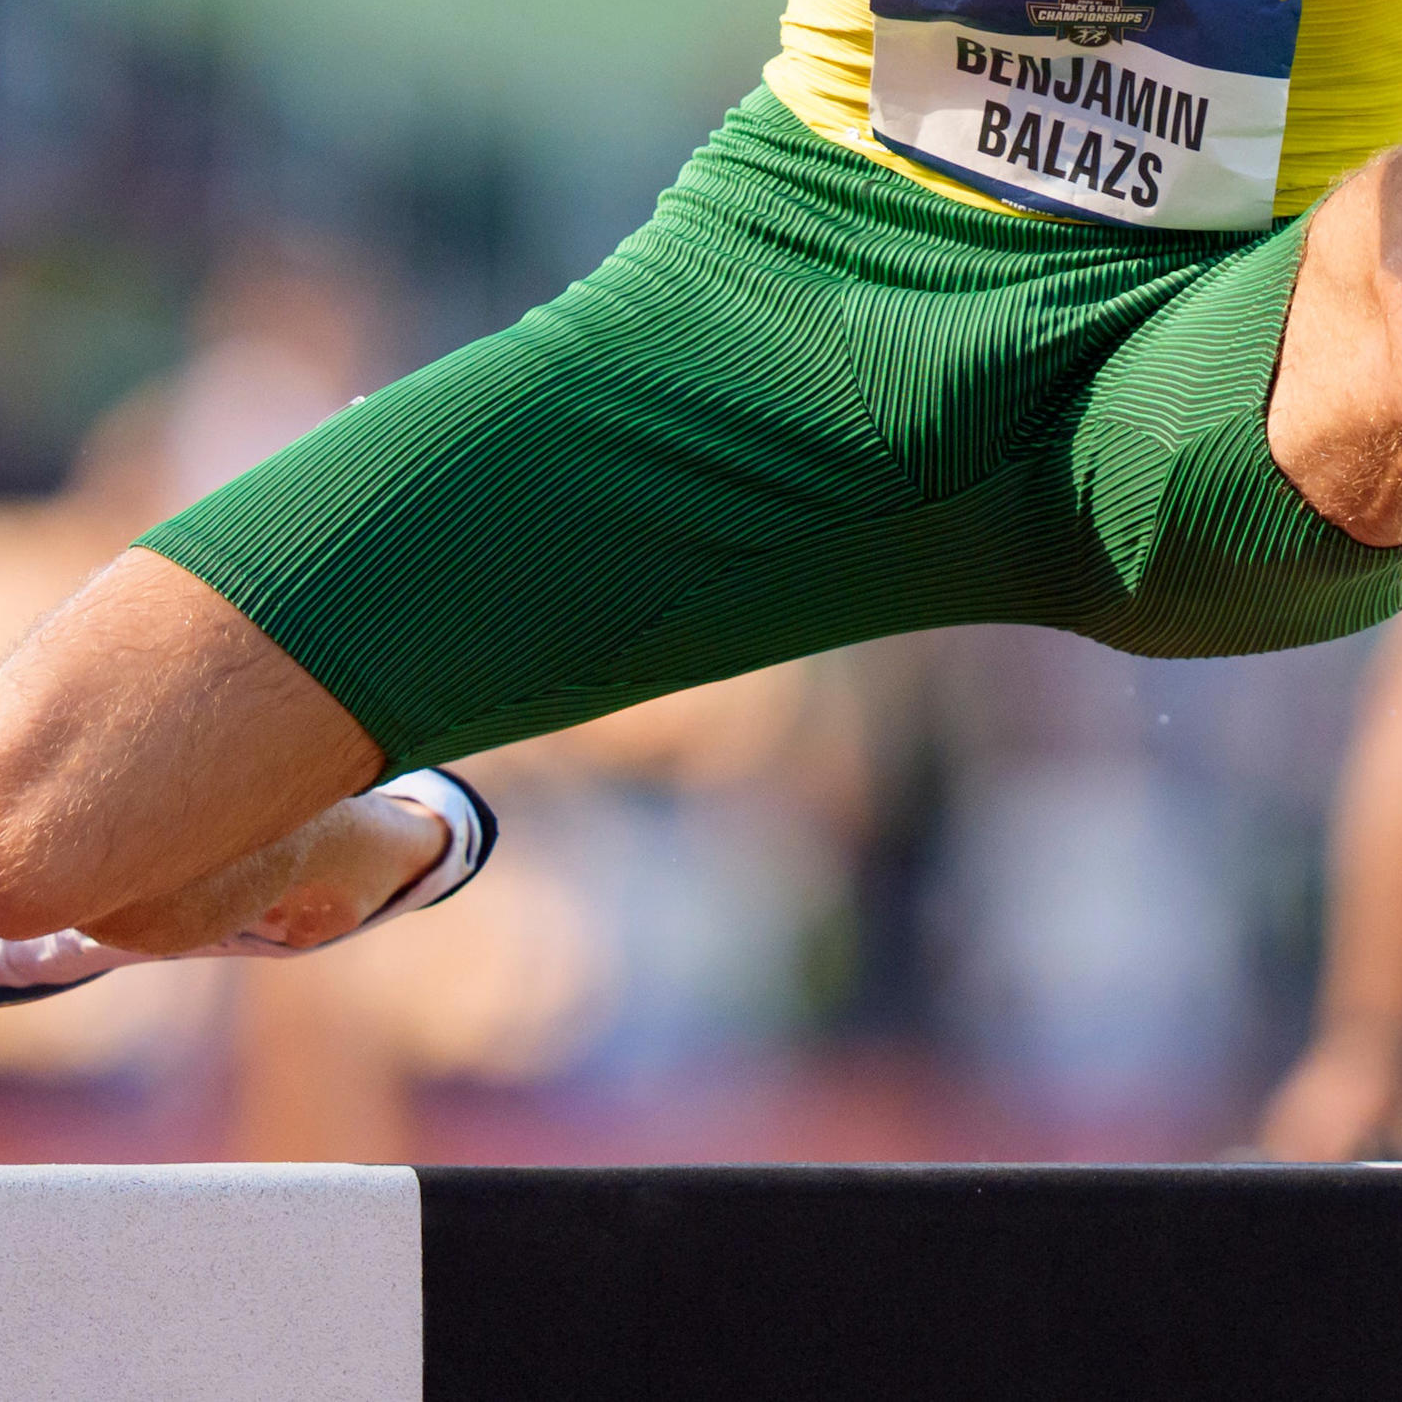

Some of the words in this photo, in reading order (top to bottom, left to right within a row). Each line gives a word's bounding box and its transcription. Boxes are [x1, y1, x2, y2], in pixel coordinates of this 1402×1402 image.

[1037, 10, 1143, 24] CHAMPIONSHIPS
[1059, 2, 1087, 12] TRACK
[1097, 4, 1120, 13] FIELD
[956, 36, 1209, 152] BENJAMIN
[977, 99, 1162, 208] BALAZS
